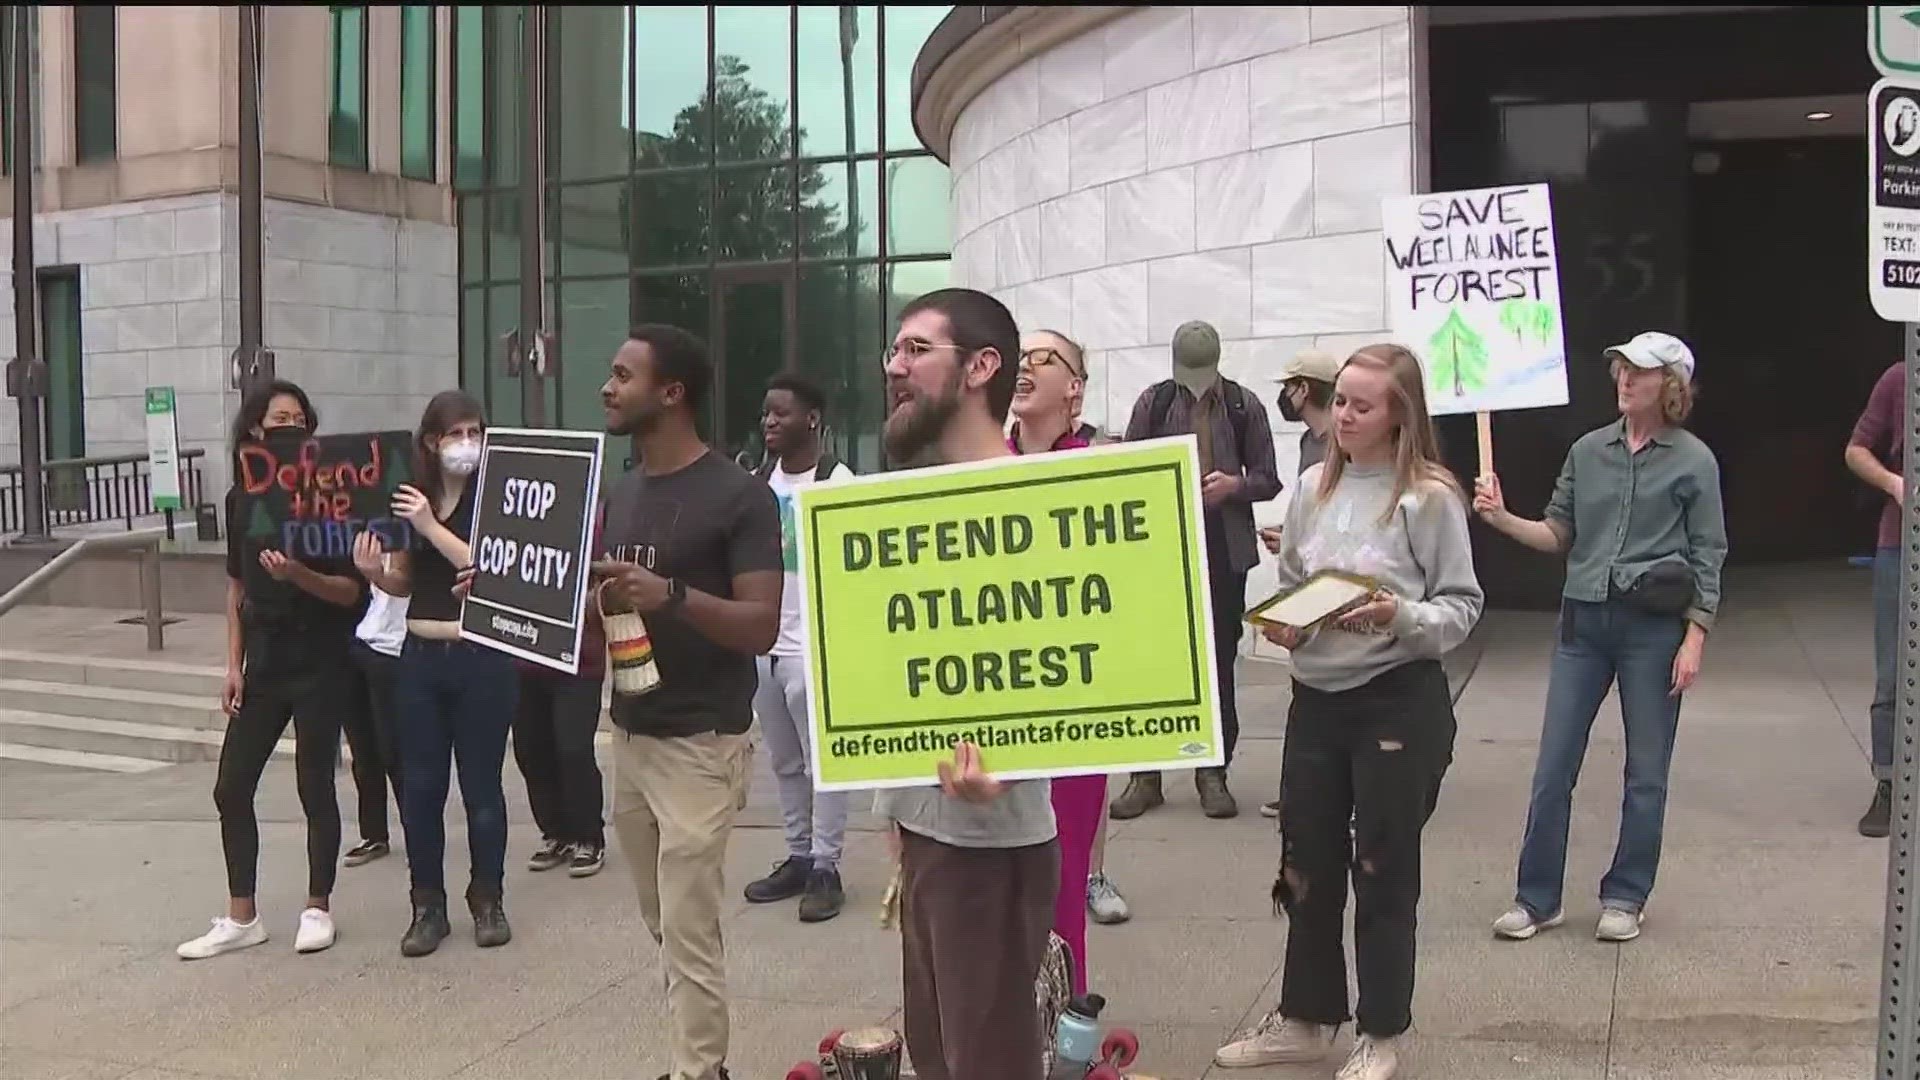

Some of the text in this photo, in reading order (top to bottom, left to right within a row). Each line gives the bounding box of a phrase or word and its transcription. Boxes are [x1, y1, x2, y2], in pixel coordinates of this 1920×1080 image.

[1418, 189, 1529, 231] SAVE
[1884, 236, 1916, 253] TEXT:
[1411, 266, 1550, 310] FOREST
[239, 435, 381, 493] Defend
[291, 488, 350, 521] the
[502, 477, 557, 520] STOP
[842, 499, 1150, 572] DEFEND THE
[478, 534, 571, 590] COP CITY
[887, 573, 1113, 634] ATLANTA
[907, 642, 1100, 699] FOREST
[831, 713, 1201, 759] defendtheatlantaforest.com
